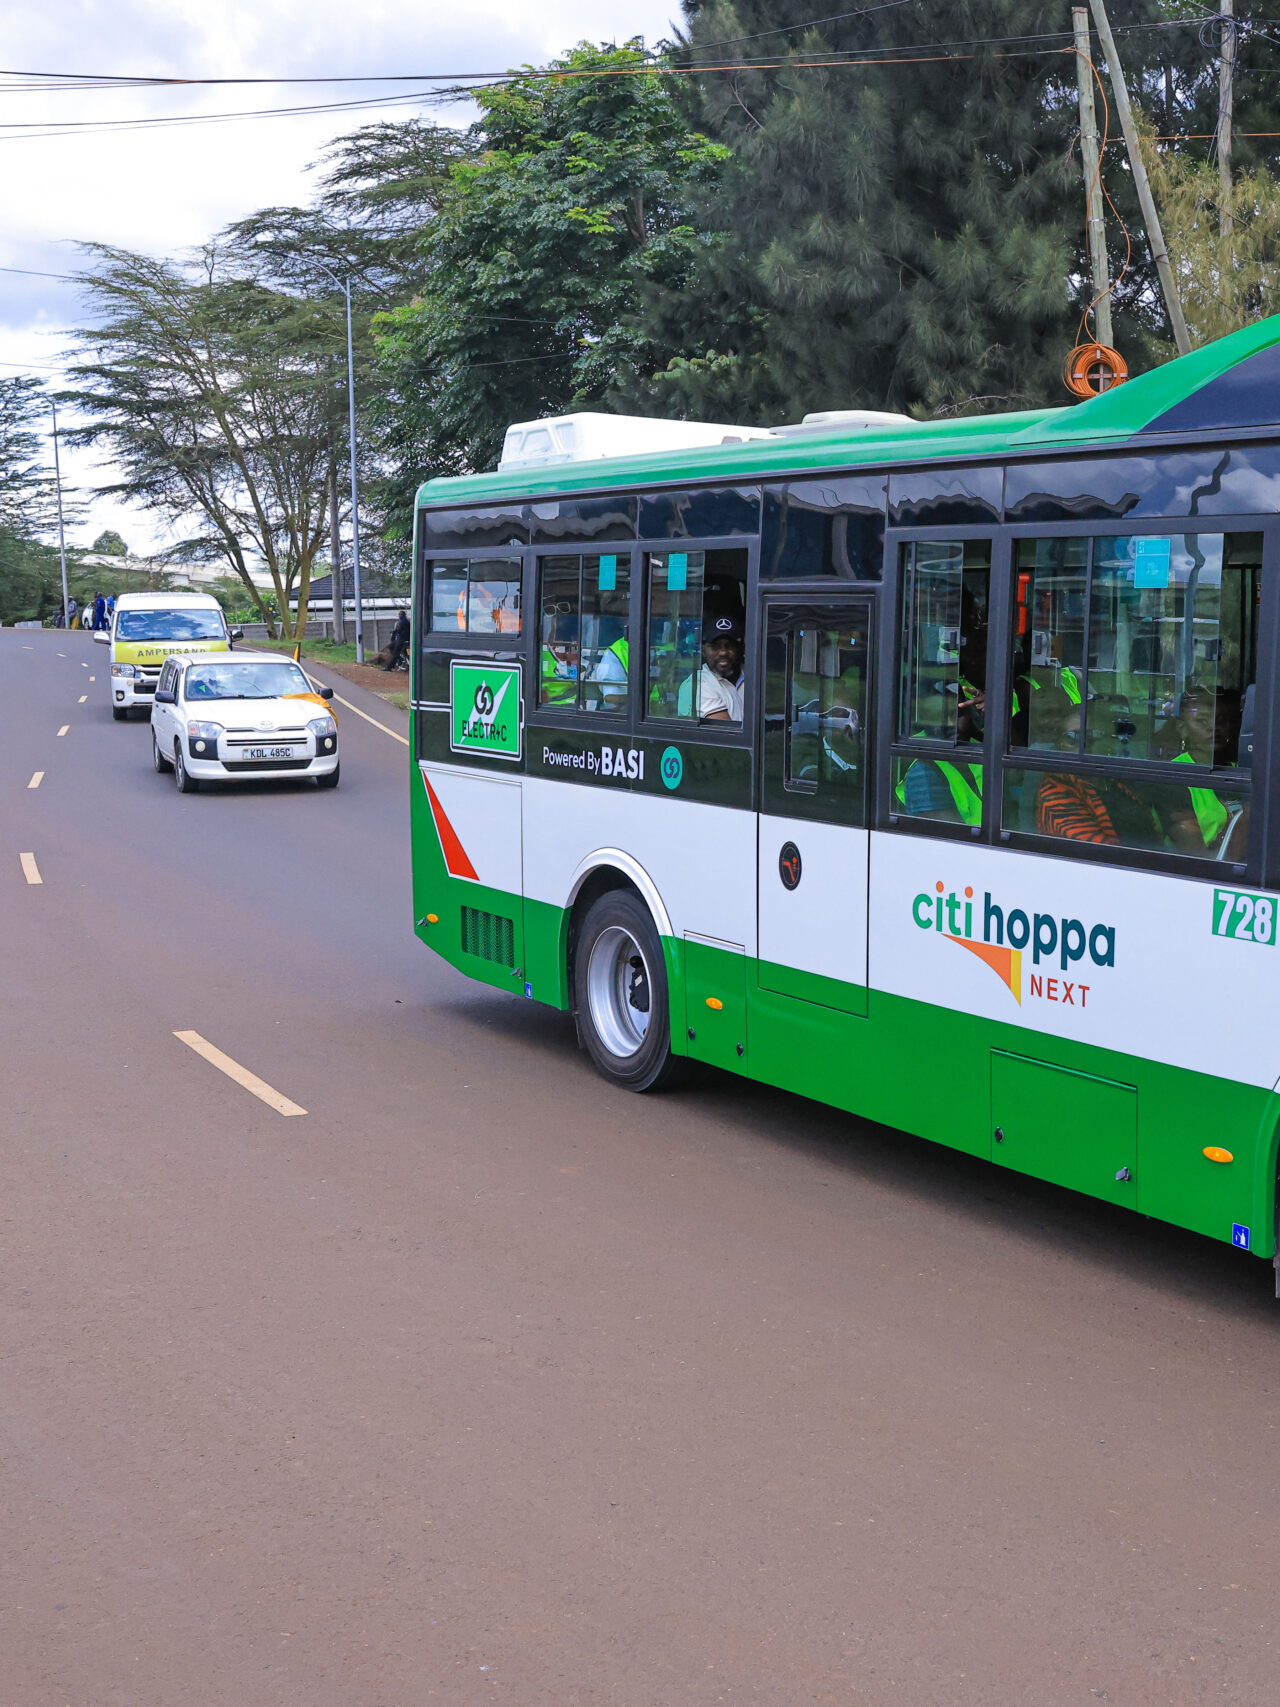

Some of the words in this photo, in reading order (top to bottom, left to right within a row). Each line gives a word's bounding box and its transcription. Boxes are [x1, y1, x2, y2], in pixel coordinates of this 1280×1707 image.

[250, 748, 267, 758] KDL
[270, 748, 291, 757] 485C
[543, 746, 586, 769] Powered
[587, 751, 601, 775] By
[912, 880, 974, 938] citi
[983, 891, 1116, 971] hoppa
[1216, 892, 1274, 943] 728
[1030, 973, 1091, 1008] NEXT
